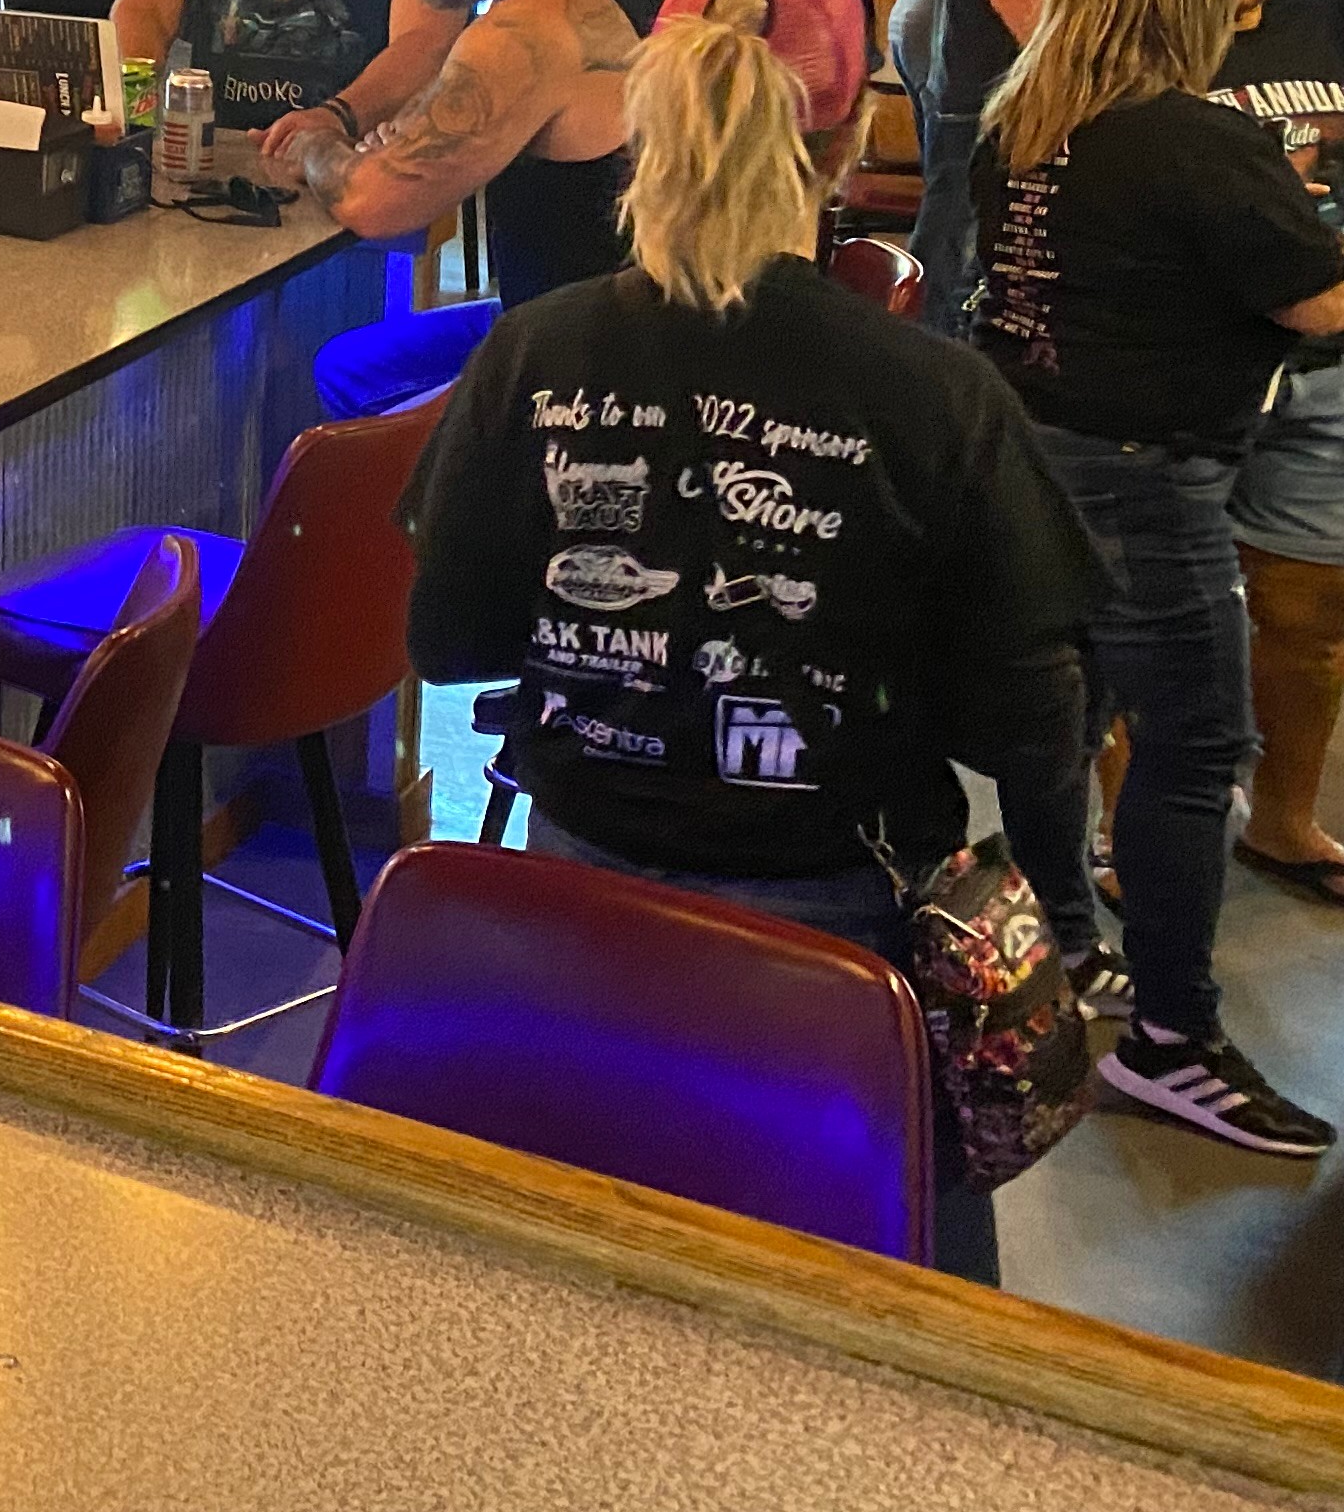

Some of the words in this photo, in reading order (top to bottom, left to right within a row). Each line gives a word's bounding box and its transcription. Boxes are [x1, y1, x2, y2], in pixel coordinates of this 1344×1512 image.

[1245, 80, 1344, 117] ANNUA
[600, 391, 625, 427] to
[719, 482, 843, 539] Shore
[531, 616, 582, 650] &K
